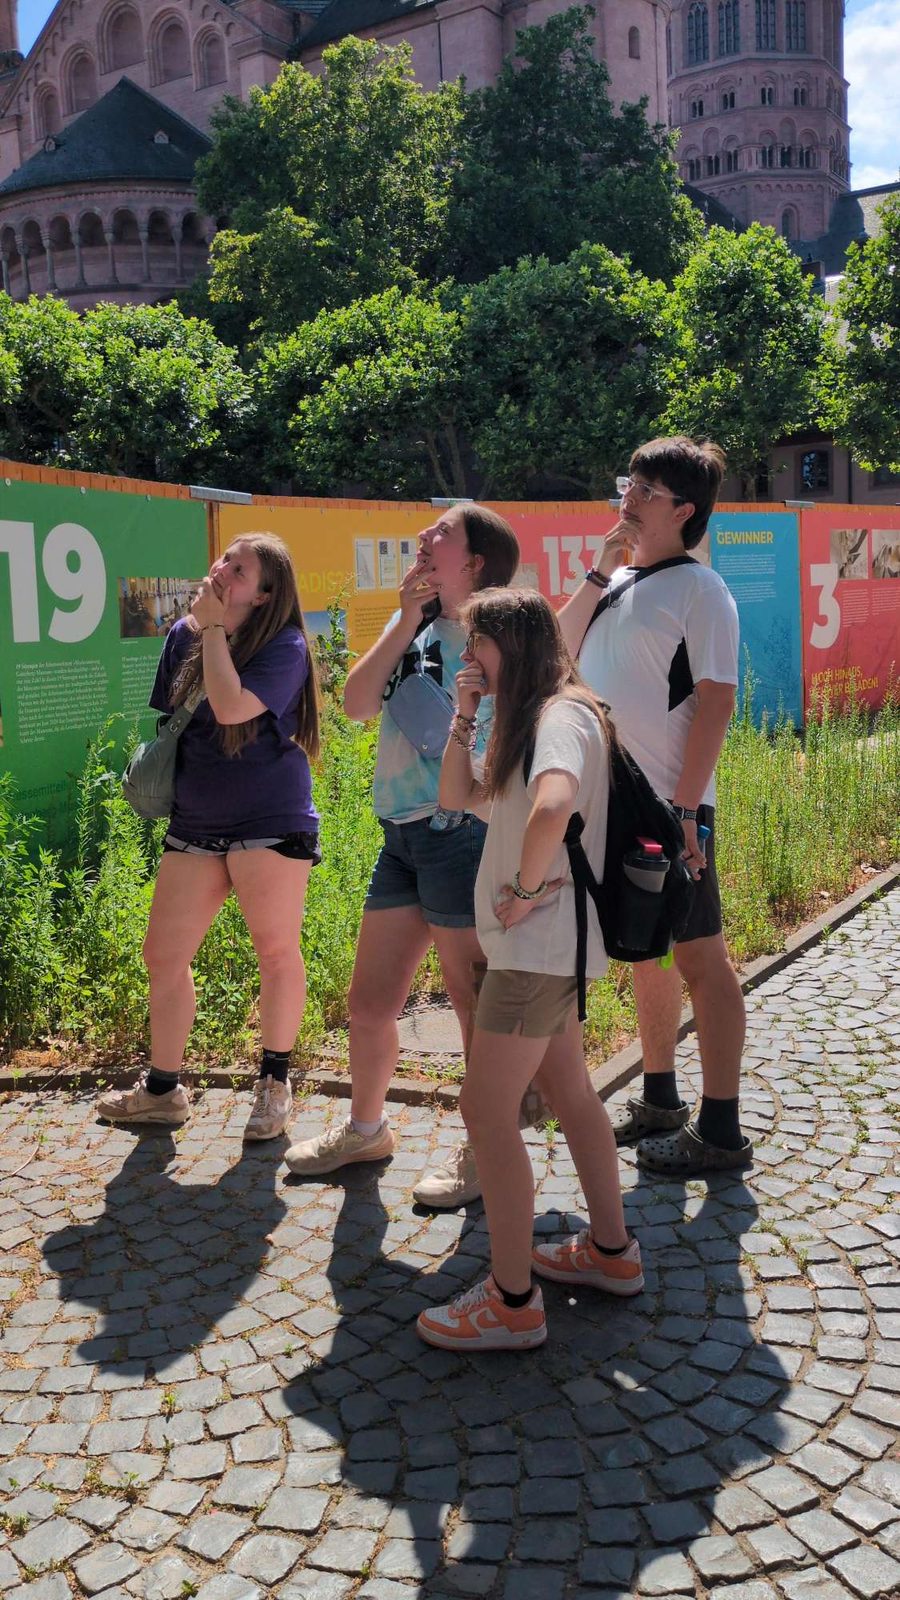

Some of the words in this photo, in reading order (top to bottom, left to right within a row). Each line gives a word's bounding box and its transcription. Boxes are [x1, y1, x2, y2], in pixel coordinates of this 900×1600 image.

[0, 519, 107, 643] 19
[716, 531, 774, 545] GEWINNER
[809, 562, 841, 650] 3
